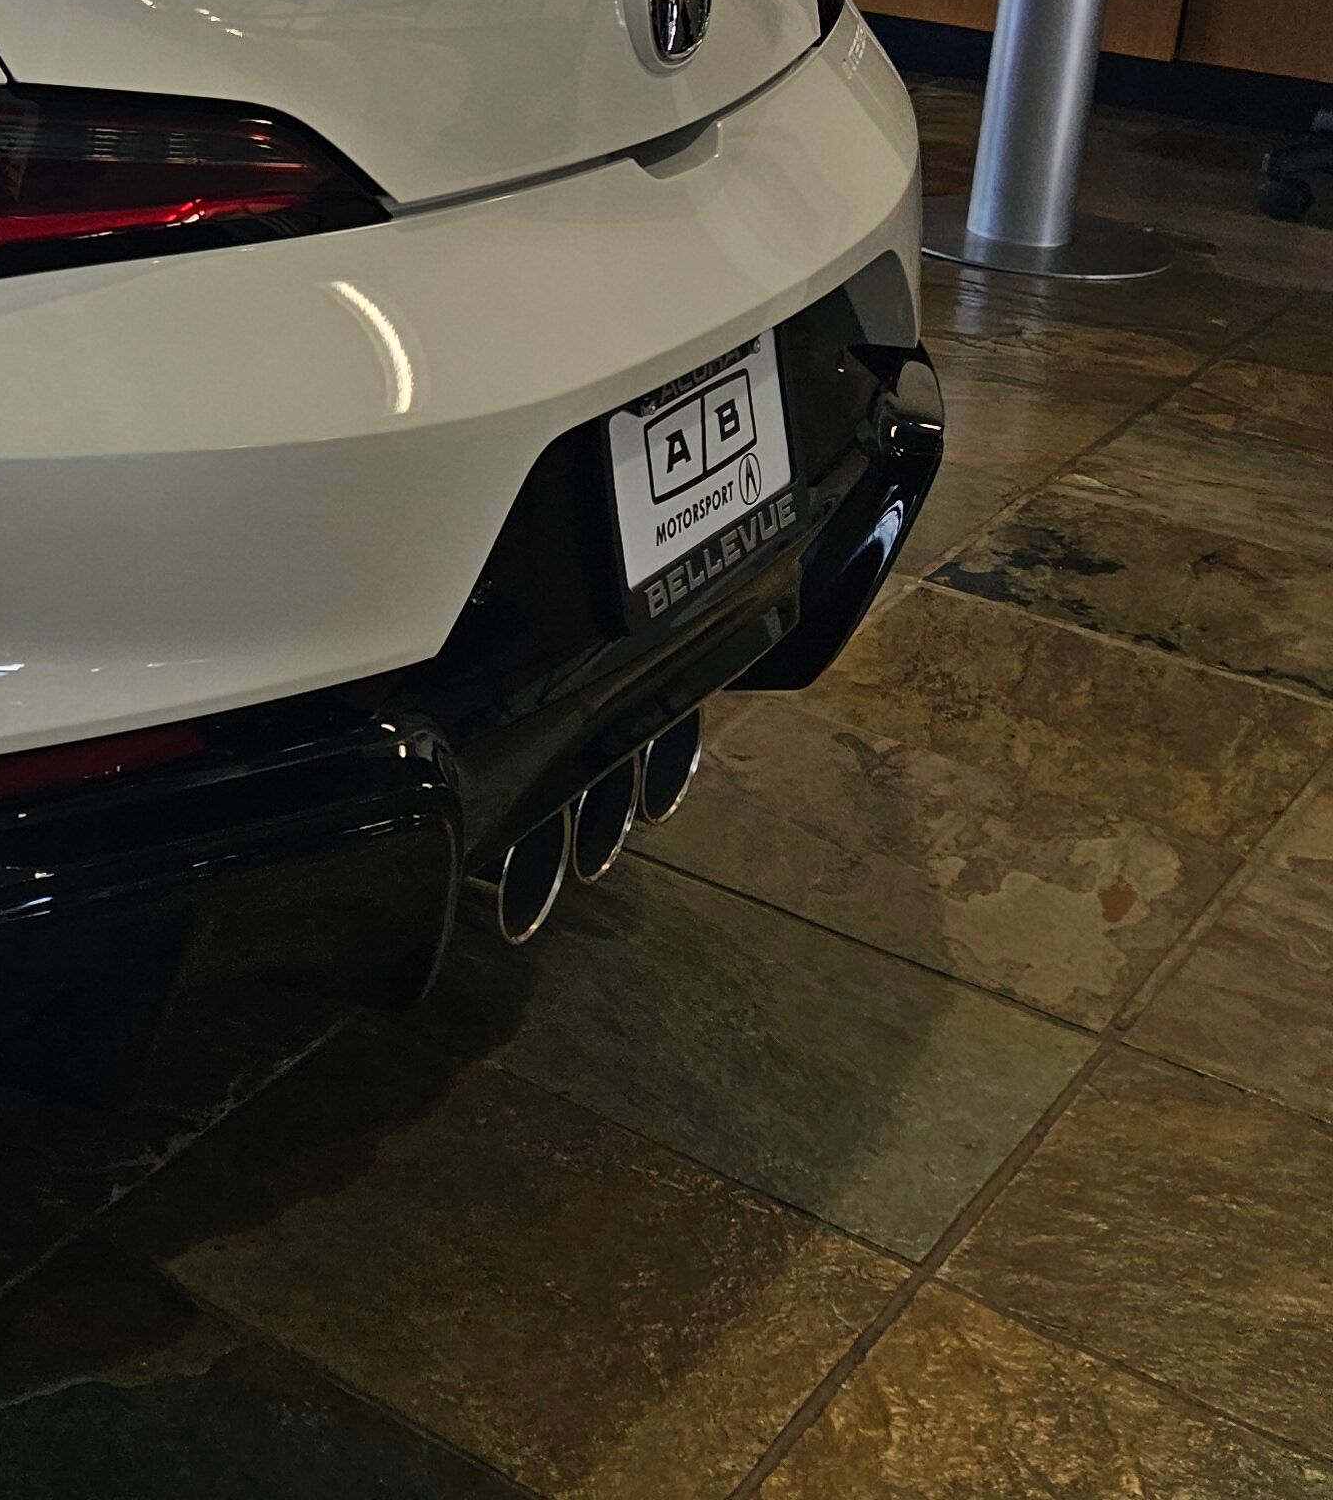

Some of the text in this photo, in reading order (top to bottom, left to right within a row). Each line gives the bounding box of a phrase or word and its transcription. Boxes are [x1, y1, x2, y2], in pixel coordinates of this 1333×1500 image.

[666, 397, 741, 474] A B
[655, 480, 734, 547] MOTORSPORT
[643, 492, 797, 619] BELLEVUE
